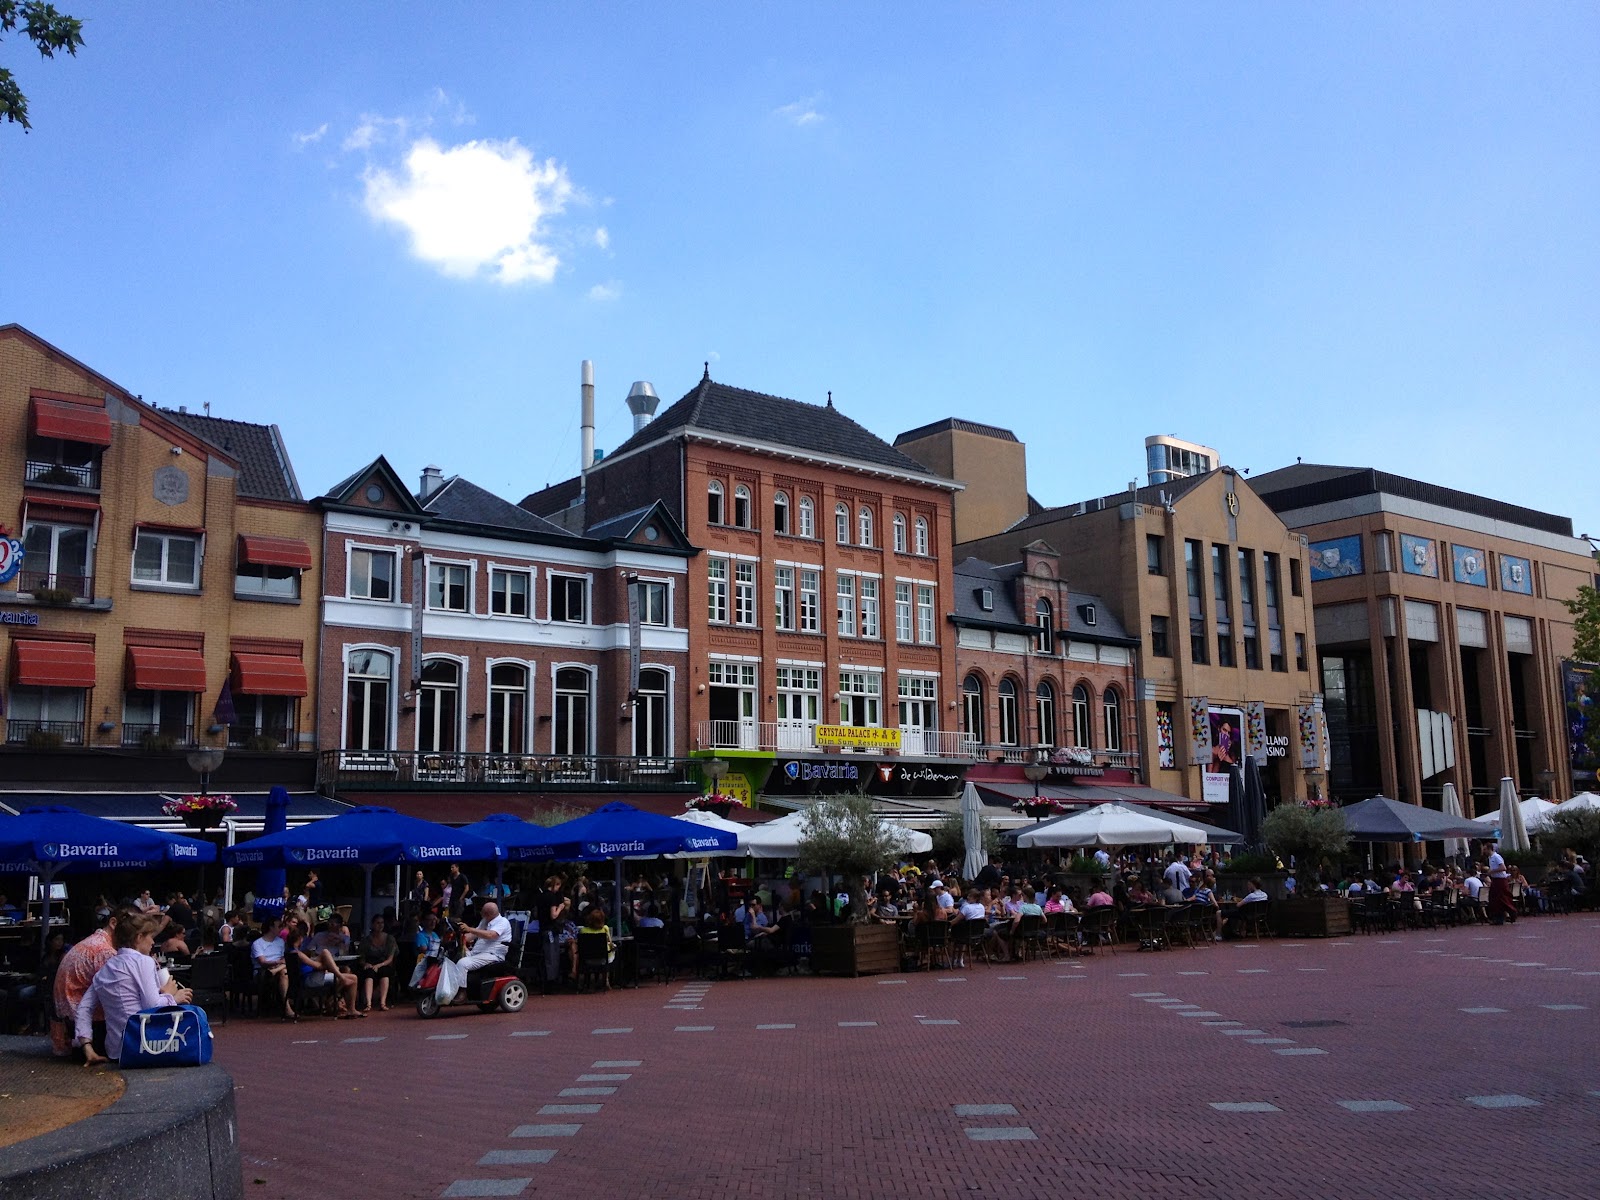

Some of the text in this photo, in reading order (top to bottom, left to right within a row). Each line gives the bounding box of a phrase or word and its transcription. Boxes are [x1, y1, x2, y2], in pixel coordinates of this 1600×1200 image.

[819, 727, 846, 737] CRYSTAL
[848, 728, 870, 738] PALACE
[837, 738, 854, 746] Sum
[857, 740, 899, 748] Restaurant
[1265, 735, 1289, 746] LLAND
[1265, 746, 1285, 757] ASINO
[801, 761, 858, 780] Bavaria
[900, 767, 959, 781] de wildeman
[601, 840, 645, 853] Bavaria
[692, 837, 719, 848] Bavaria
[59, 843, 118, 857] Bavaria
[174, 843, 198, 857] Bavaria
[235, 850, 264, 863] Bavaria
[307, 846, 359, 861] Bavaria
[420, 845, 462, 858] Bavaria
[519, 845, 555, 858] Bavaria
